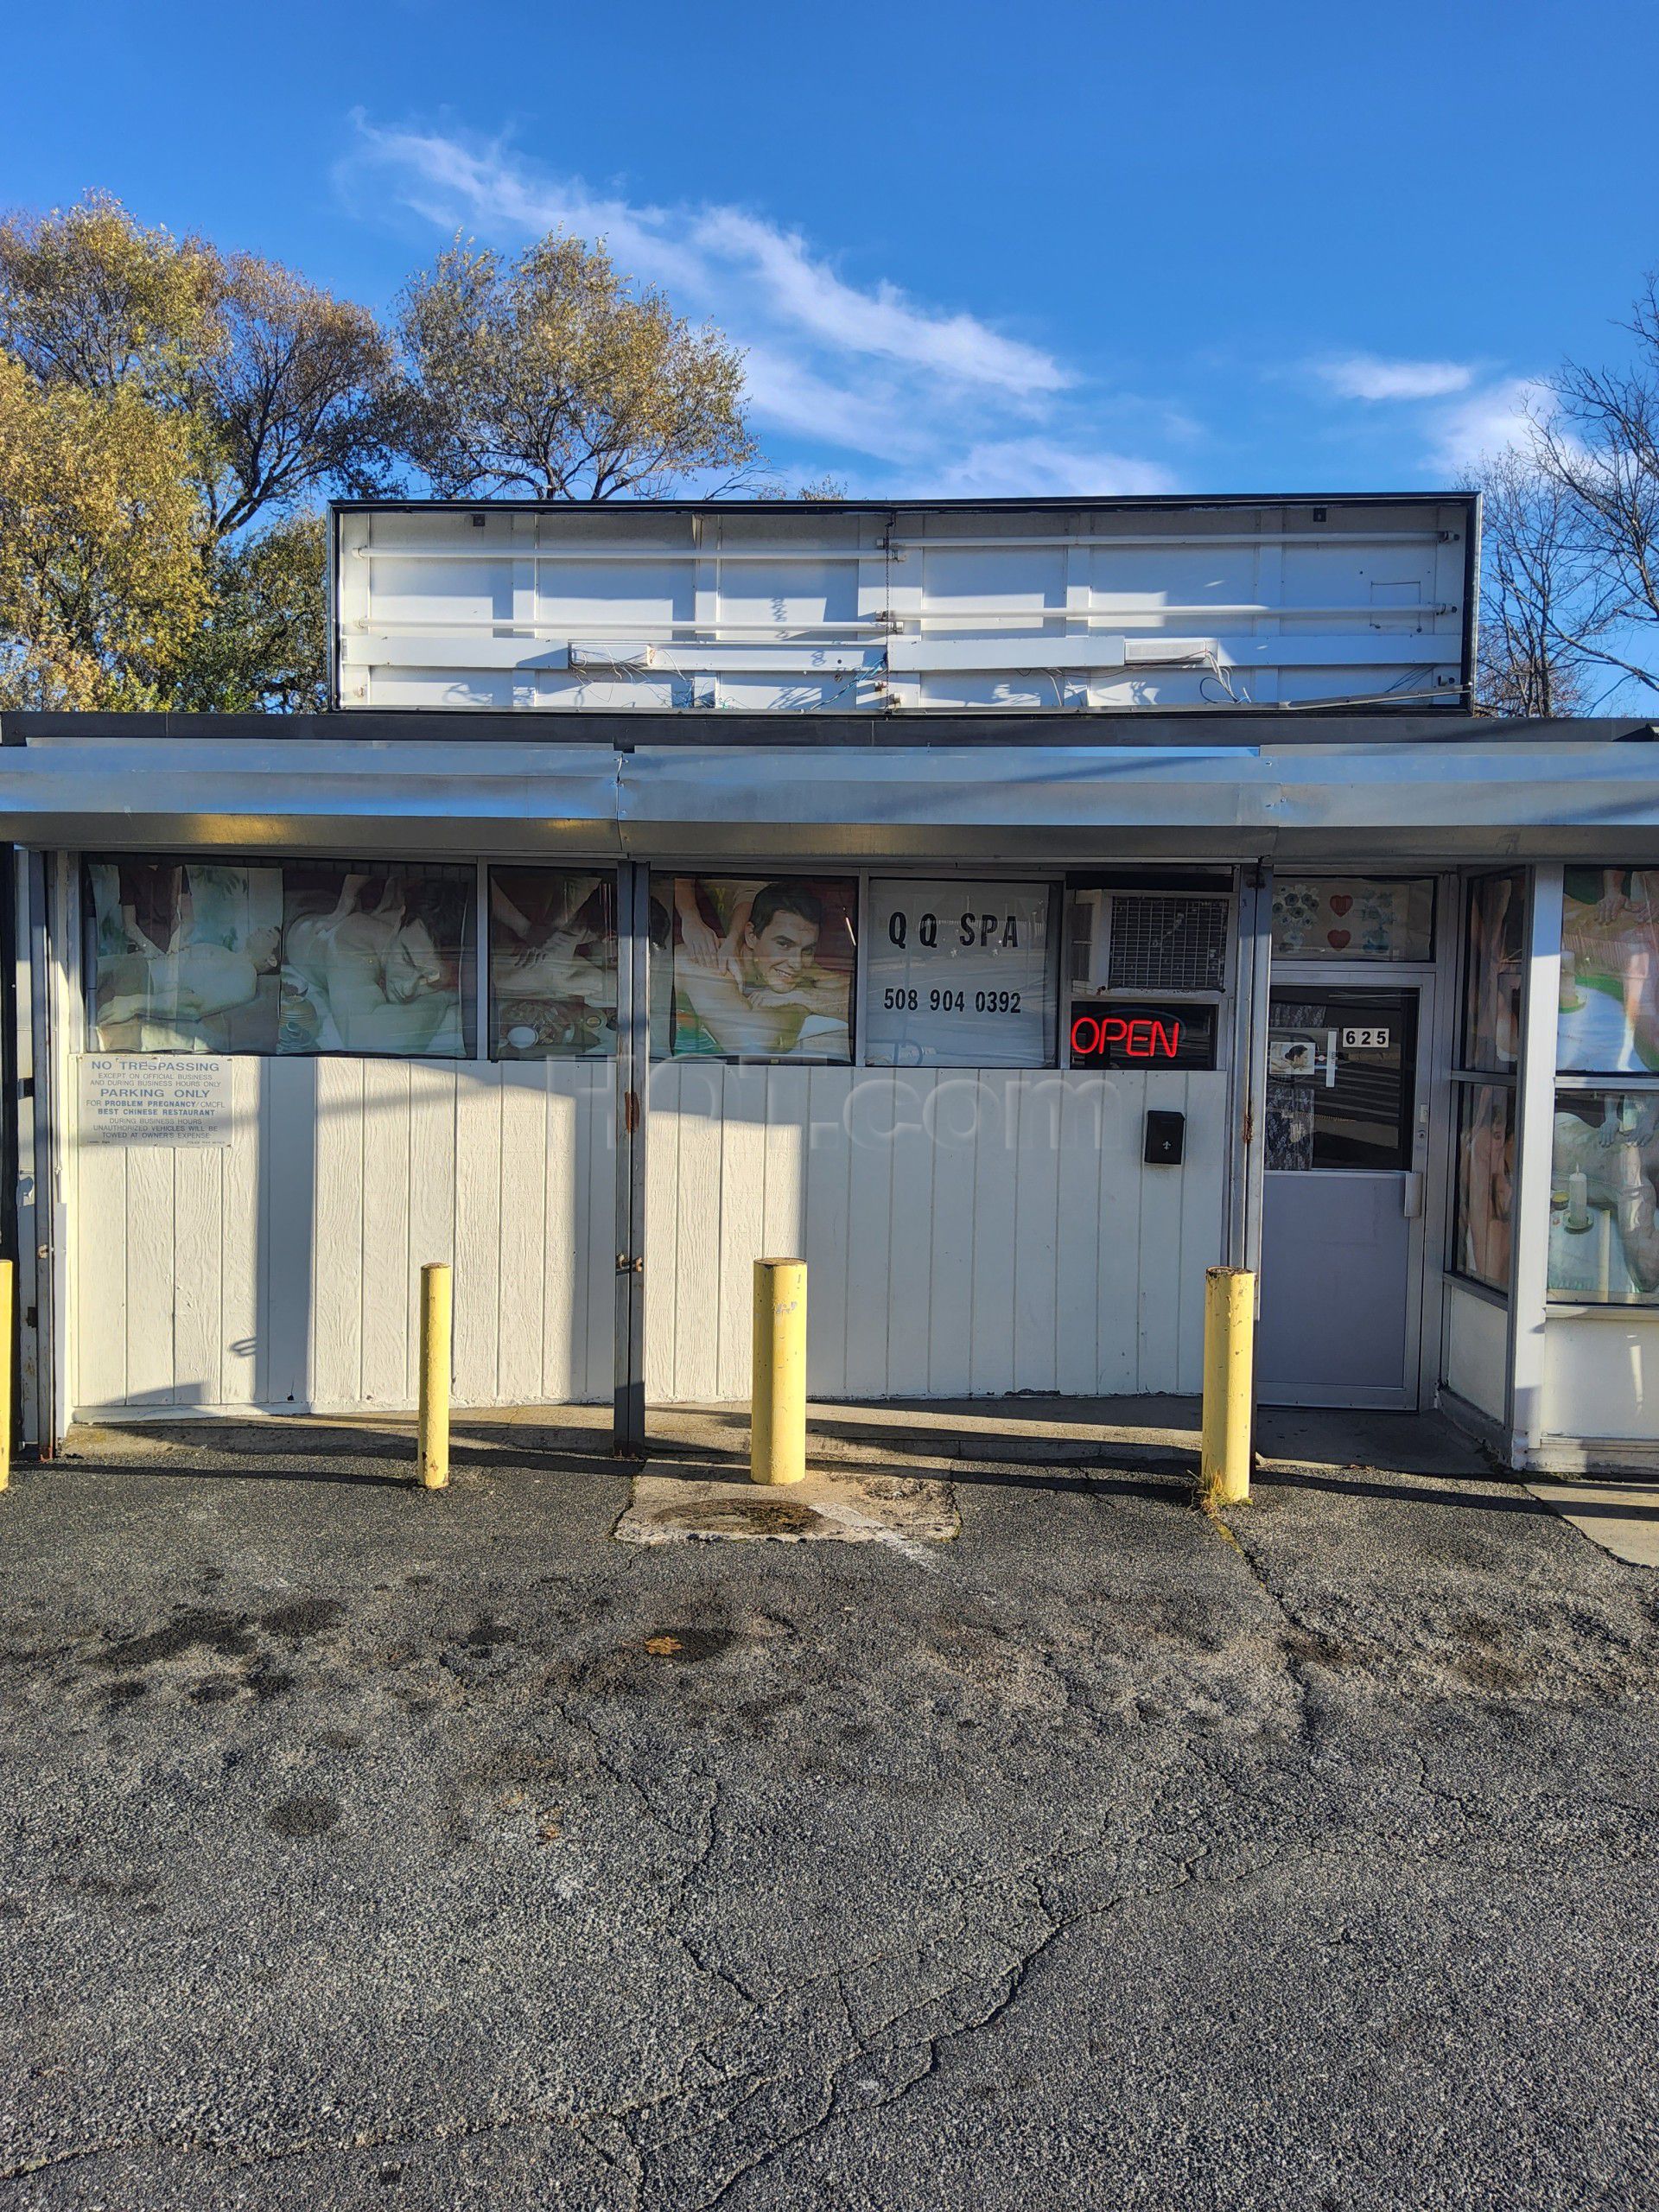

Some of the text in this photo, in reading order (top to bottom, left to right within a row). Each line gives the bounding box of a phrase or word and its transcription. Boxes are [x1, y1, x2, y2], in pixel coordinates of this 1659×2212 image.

[888, 912, 1019, 950] Q Q SPA
[884, 988, 1021, 1014] 508 904 0392
[1071, 1016, 1180, 1058] OPEN
[1345, 1030, 1387, 1045] 625
[92, 1061, 219, 1071] NO TRESPASSING
[100, 1089, 210, 1098] PARKING ONLY
